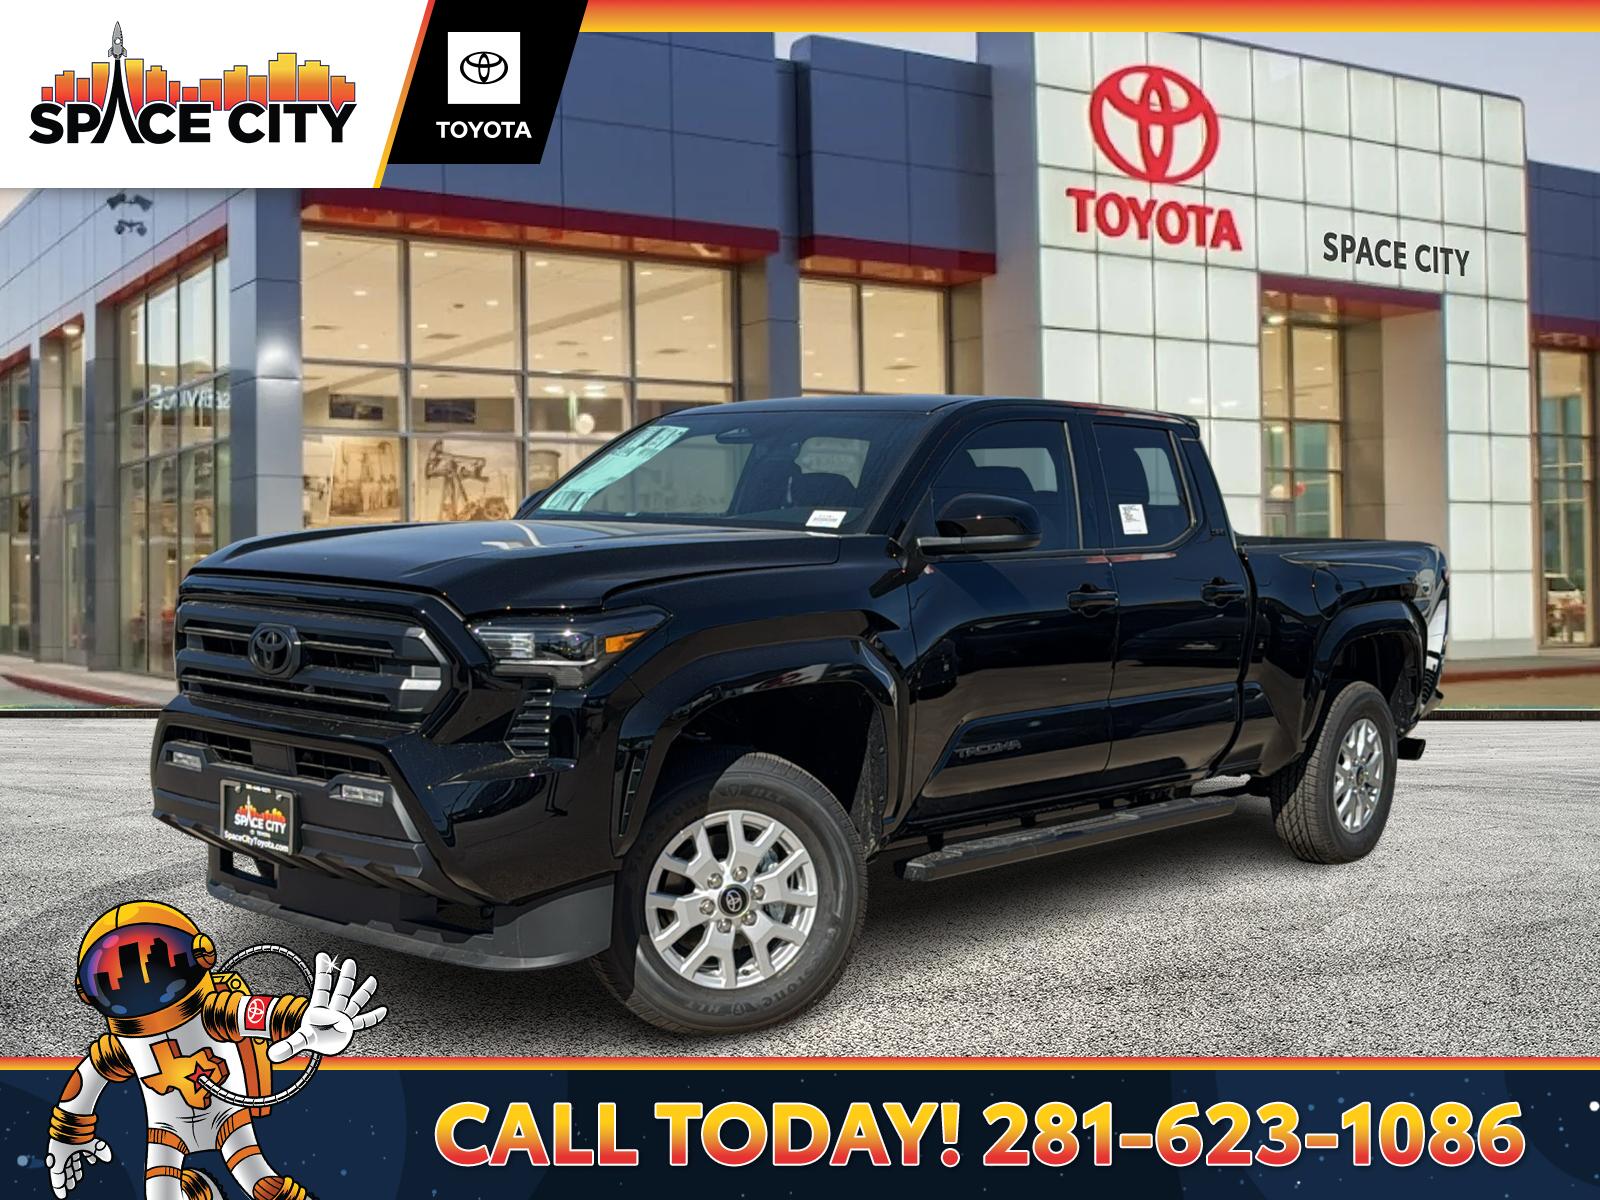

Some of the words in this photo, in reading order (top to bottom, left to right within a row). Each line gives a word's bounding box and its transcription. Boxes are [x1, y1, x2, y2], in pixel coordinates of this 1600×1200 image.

[1066, 187, 1242, 251] TOYOTA
[1323, 232, 1407, 270] SPACE
[1414, 244, 1470, 276] CITY
[234, 812, 264, 829] SPACE
[265, 820, 286, 833] CITY
[225, 830, 289, 852] SpaceCityToyota.com
